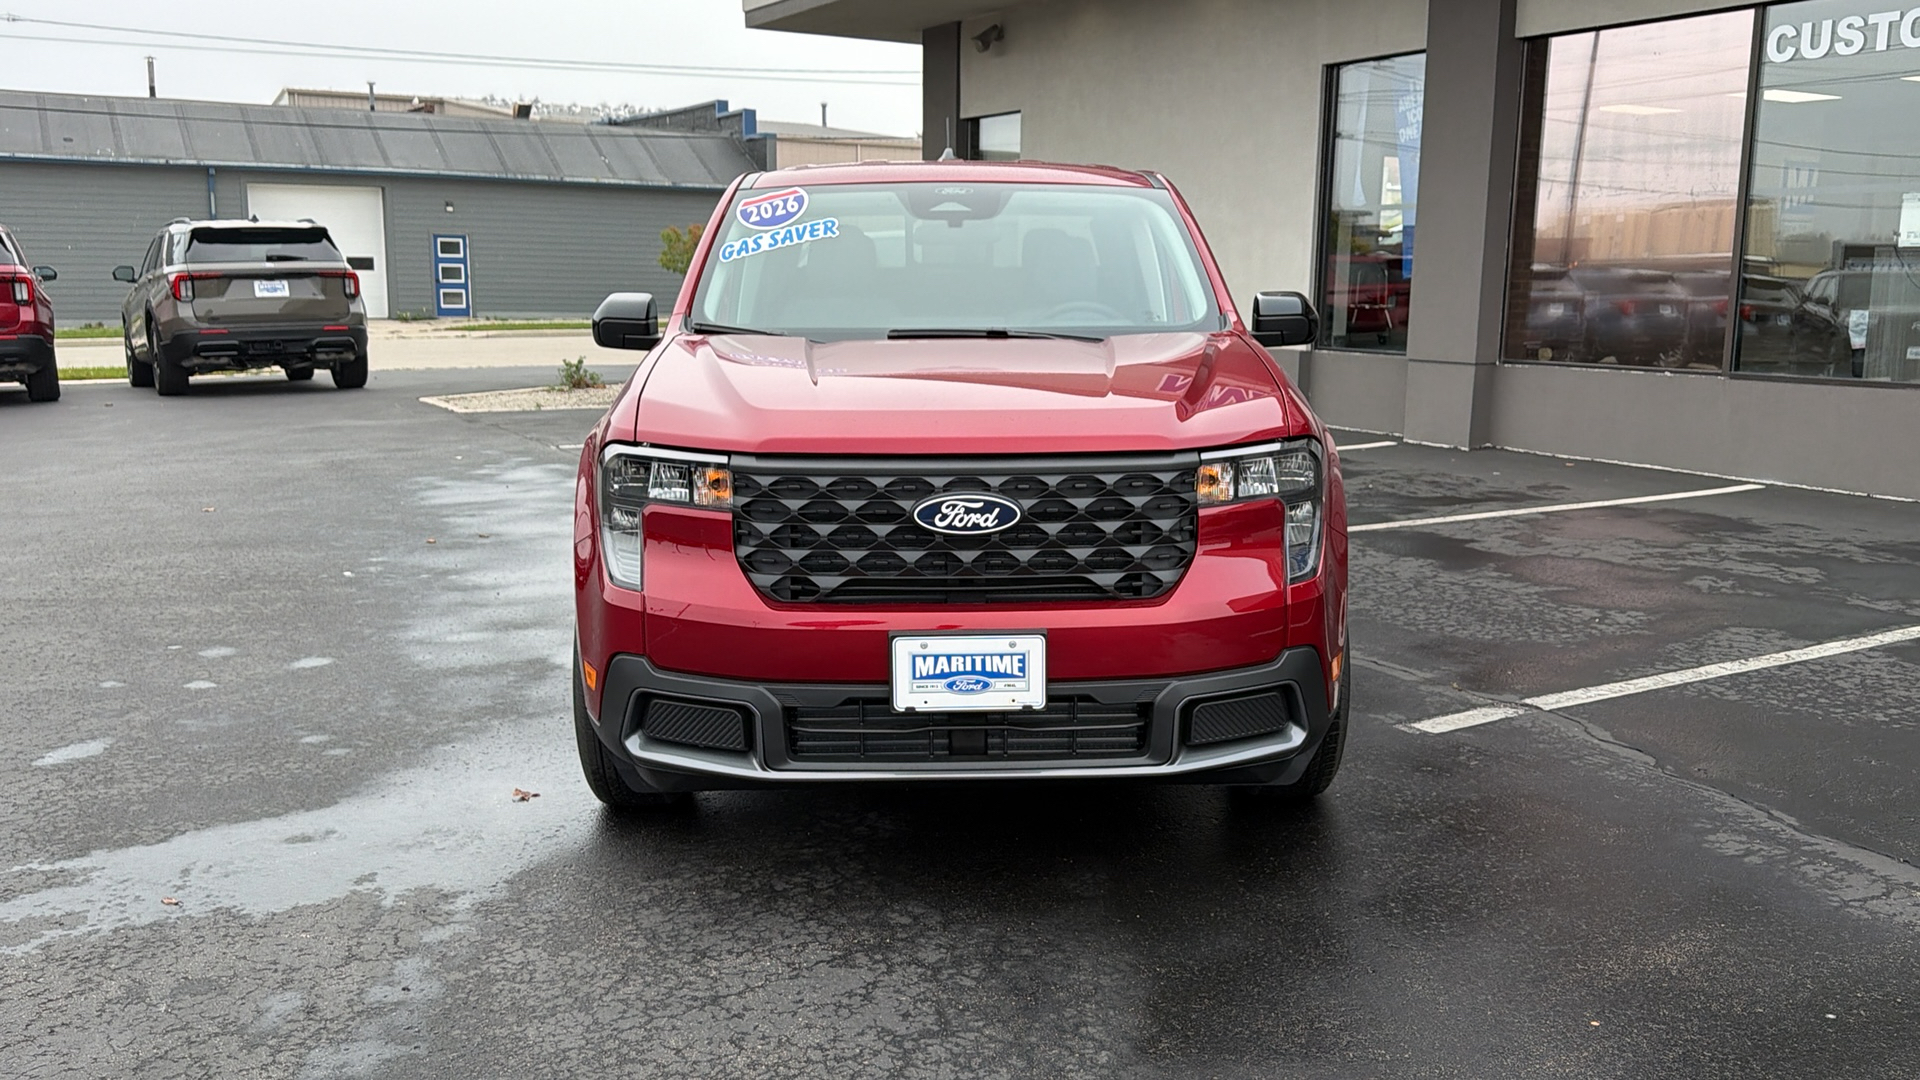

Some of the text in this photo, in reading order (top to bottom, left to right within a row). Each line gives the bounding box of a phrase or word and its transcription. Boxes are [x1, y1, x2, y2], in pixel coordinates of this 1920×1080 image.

[747, 196, 799, 223] 2026
[721, 219, 837, 261] GAS SAVER
[934, 500, 1000, 528] Ford
[915, 655, 1024, 678] MARITIME
[952, 679, 984, 691] Ford
